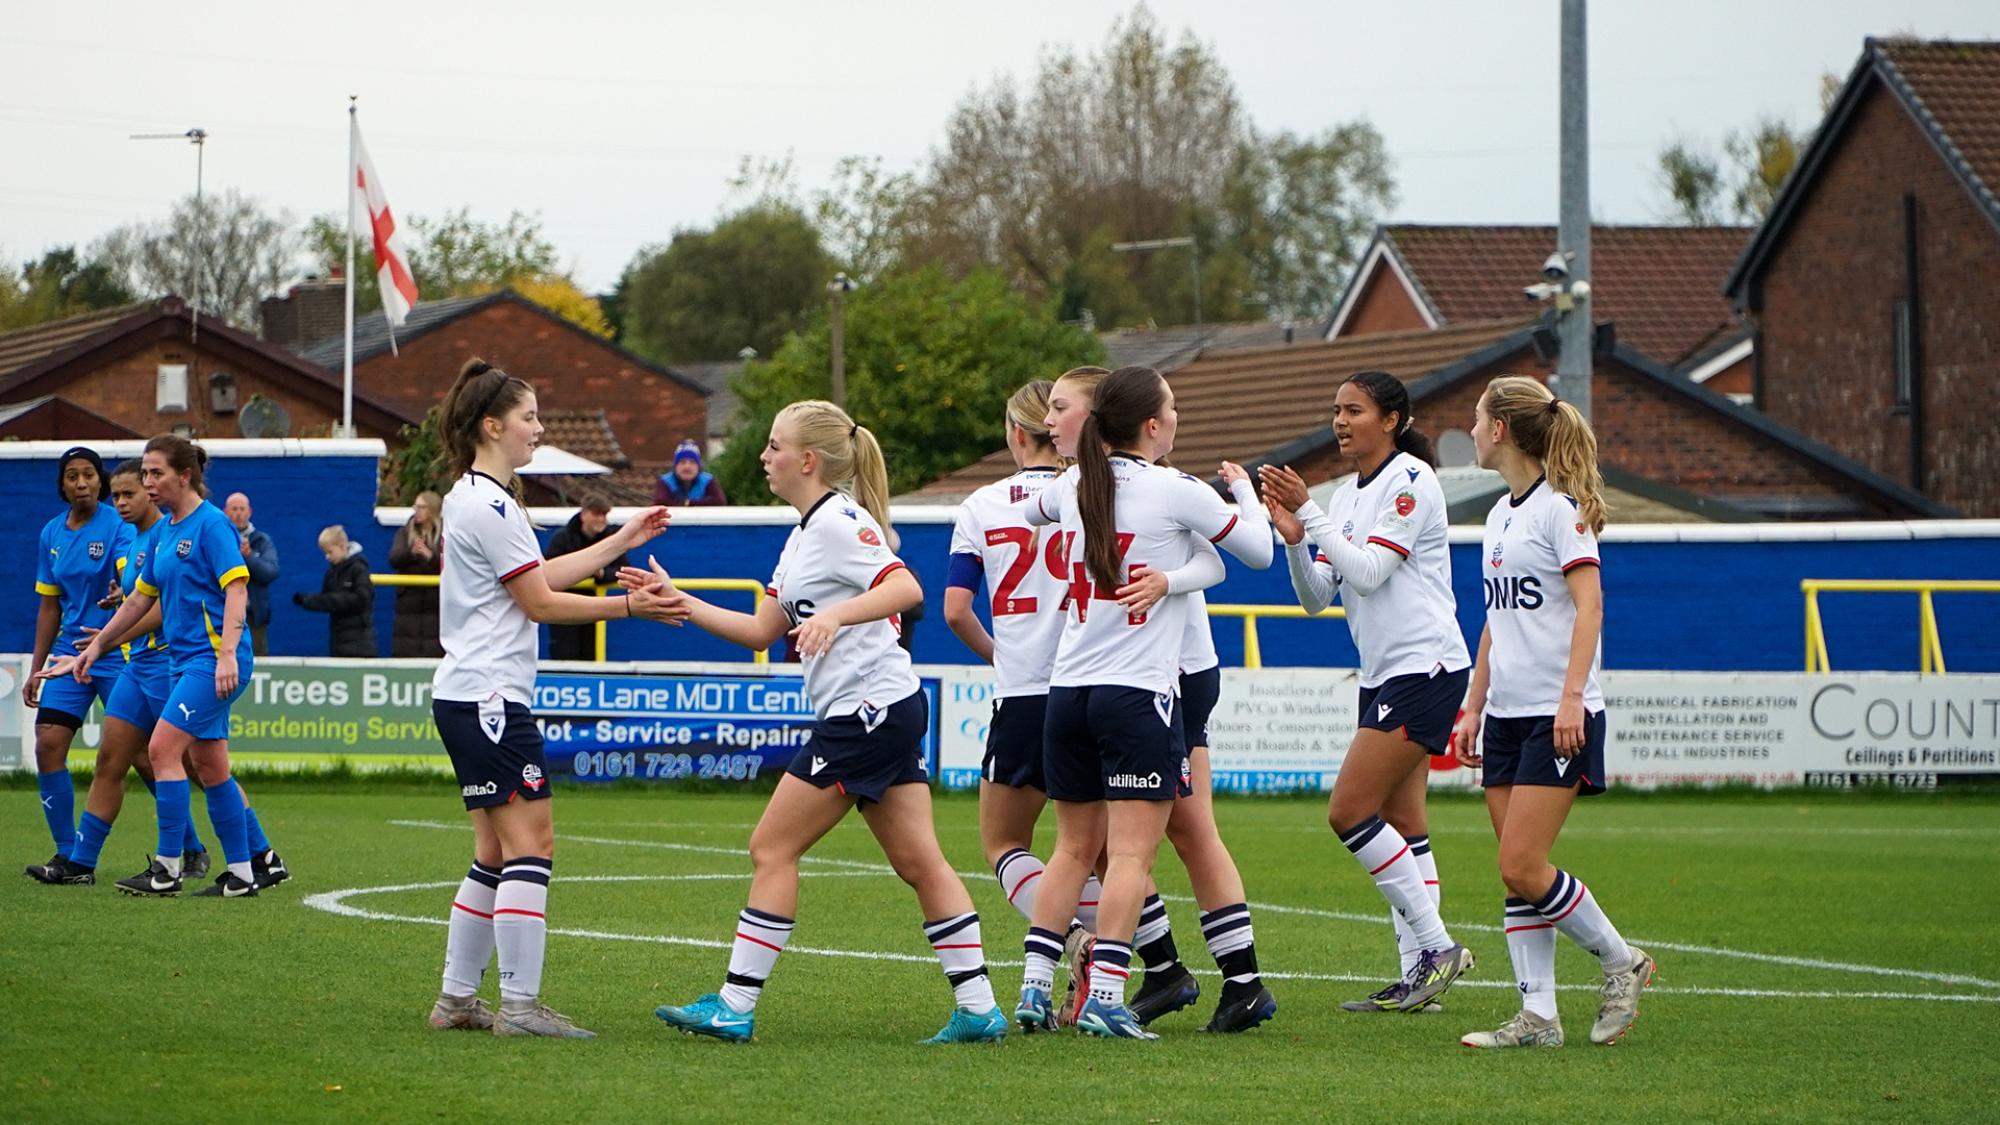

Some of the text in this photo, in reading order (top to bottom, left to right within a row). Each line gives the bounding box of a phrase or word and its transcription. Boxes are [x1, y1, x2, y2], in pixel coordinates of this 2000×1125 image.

[251, 672, 349, 706] Trees
[533, 686, 592, 708] ross
[599, 680, 669, 709] Lane
[676, 682, 741, 711] MOT
[1283, 702, 1350, 715] Windows
[1604, 696, 1798, 709] MECHANICAL FABRICATION
[1633, 713, 1768, 726] INSTALLATION AND
[1811, 683, 2000, 741] COUNT
[229, 714, 358, 744] Gardening
[596, 720, 692, 744] Service
[1616, 730, 1785, 742] MAINTENANCE SERVICE
[1216, 740, 1251, 751] ascia
[1632, 747, 1770, 759] TO ALL INDUSTRIES
[1846, 747, 1903, 767] Ceilings
[1922, 748, 1995, 765] Partitions
[574, 751, 763, 780] 0161 723 2487
[1108, 773, 1148, 788] utilita
[462, 784, 486, 797] tilita
